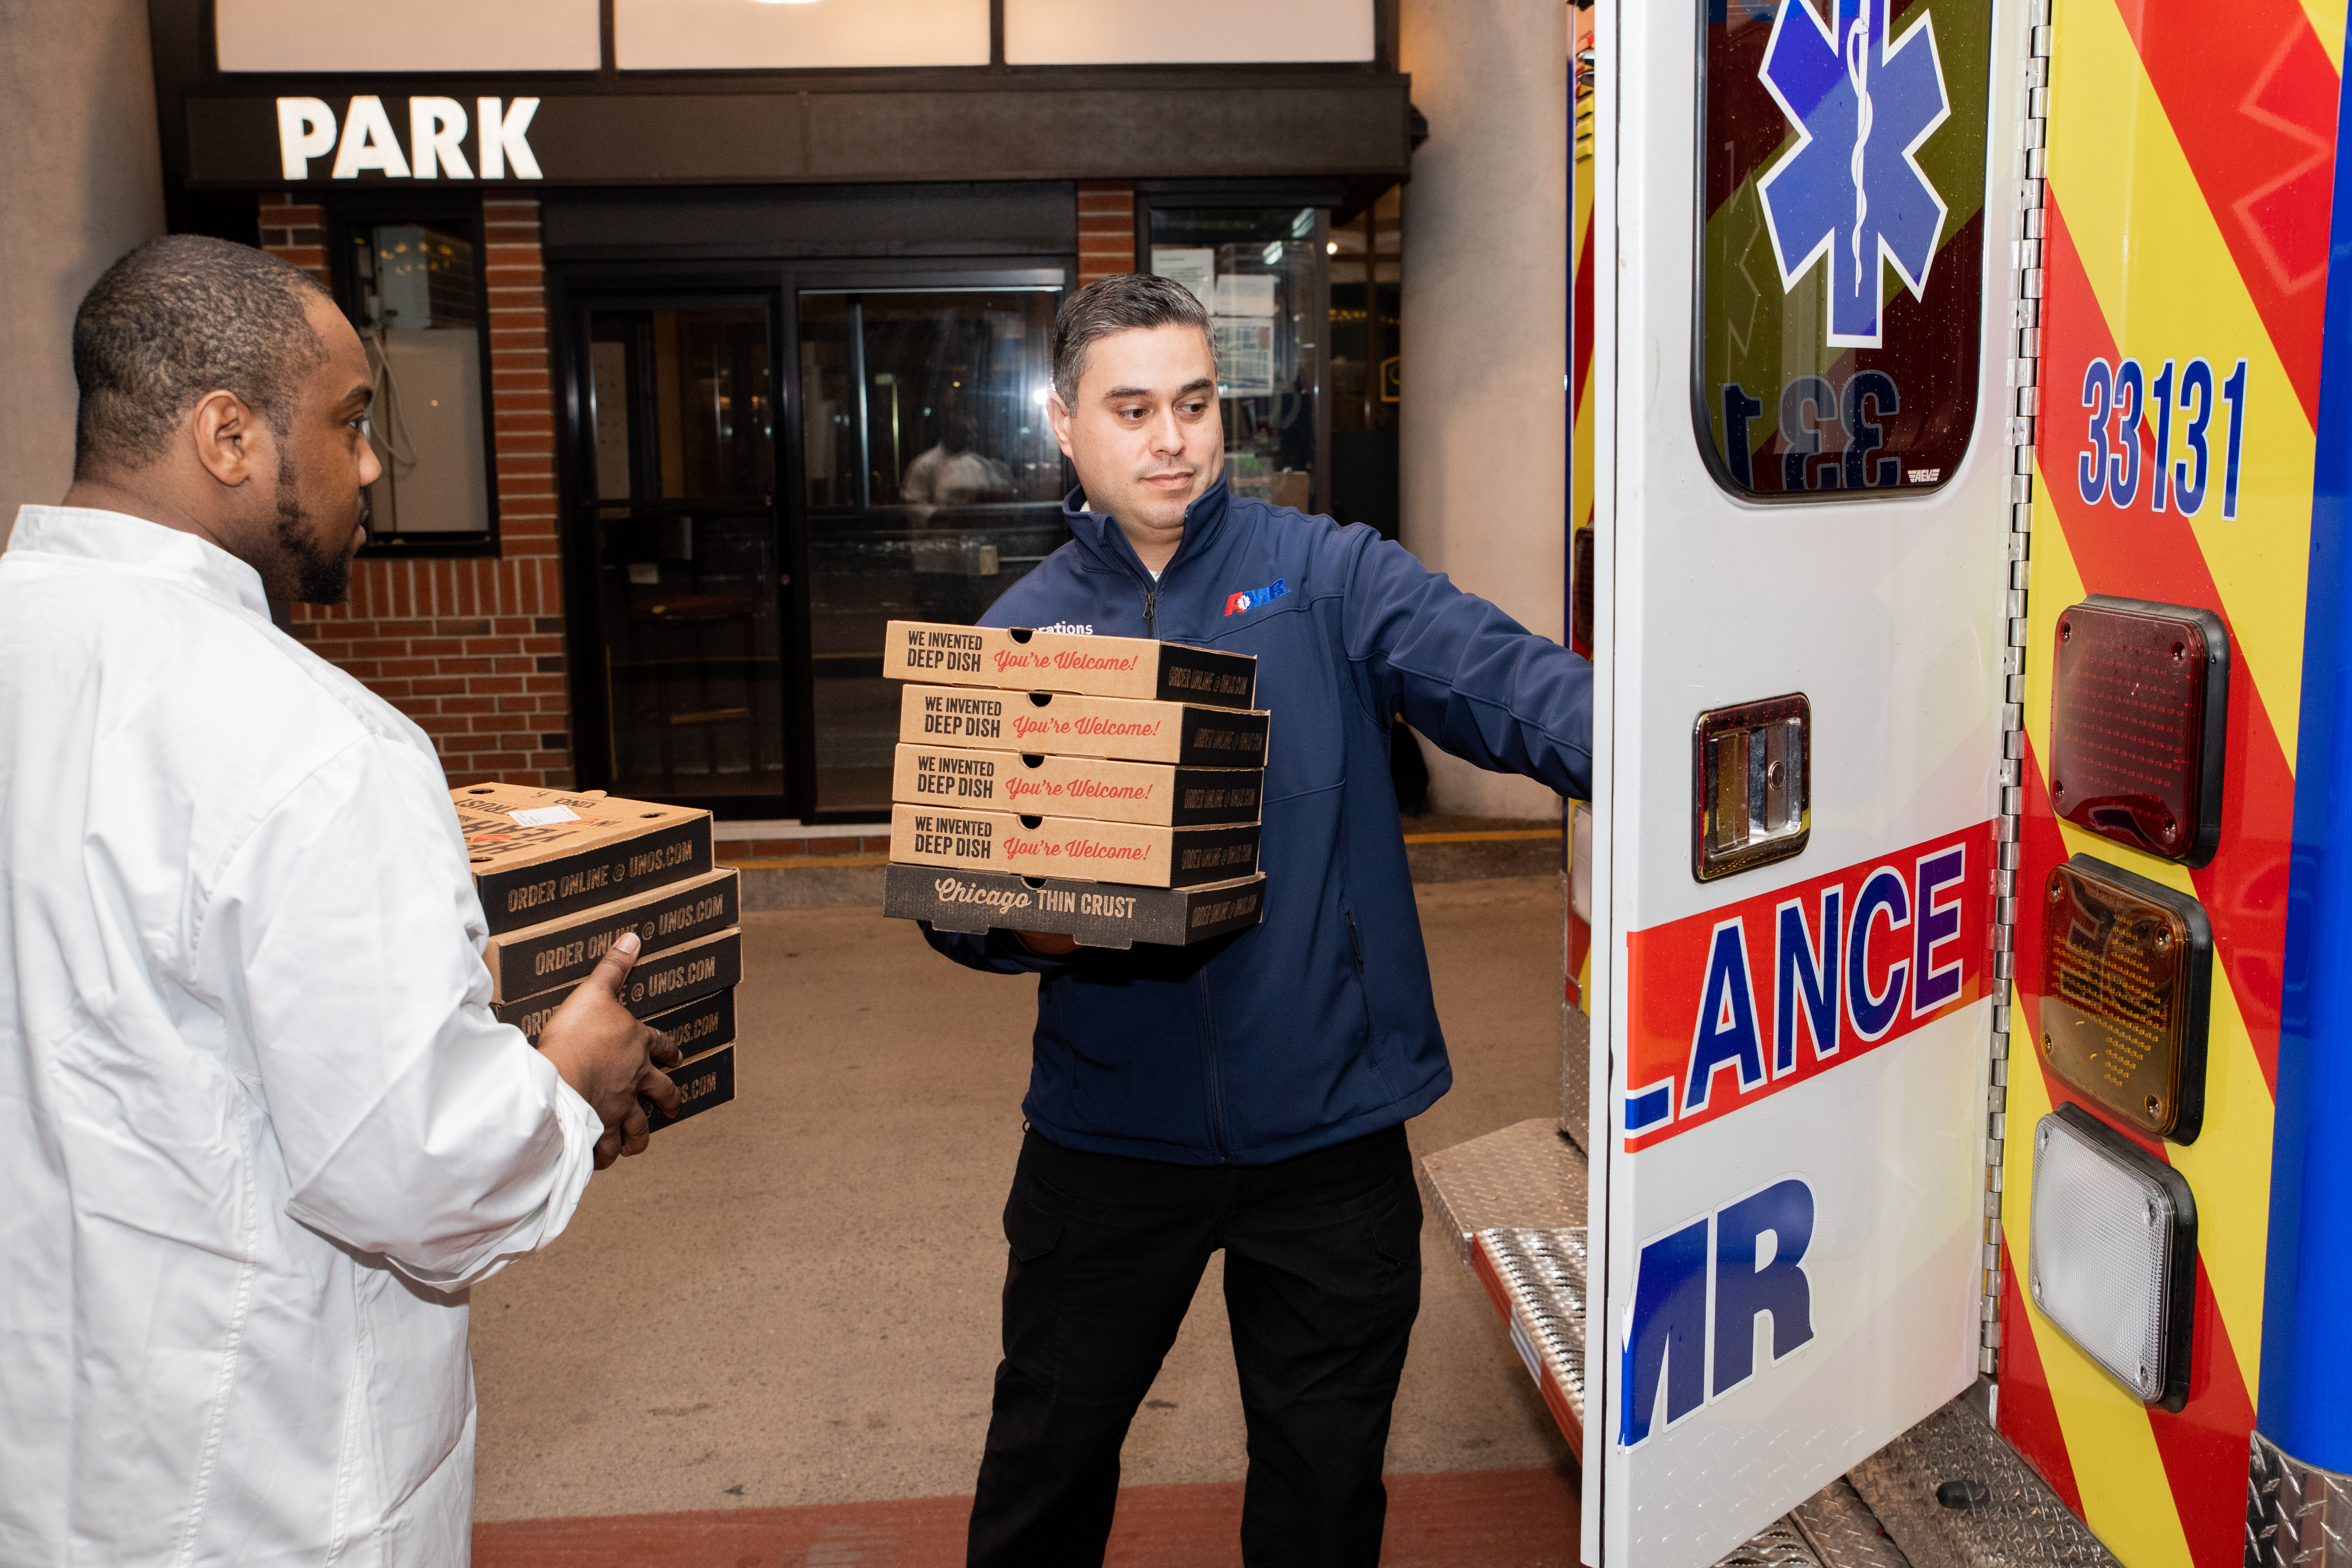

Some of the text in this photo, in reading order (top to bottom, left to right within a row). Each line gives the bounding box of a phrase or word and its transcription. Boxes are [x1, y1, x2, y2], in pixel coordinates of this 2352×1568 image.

[277, 96, 543, 180] PARK
[2079, 357, 2248, 521] 33131
[1913, 469, 1933, 483] AEV
[909, 631, 982, 650] WE INVENTED
[908, 648, 981, 672] DEEP DISH
[1054, 651, 1138, 671] Welcome!
[1168, 666, 1191, 688] ORDER
[1191, 670, 1214, 691] ONLINE
[1213, 677, 1220, 692] @
[925, 696, 1001, 716] WE INVENTED
[925, 714, 1000, 738] DEEP DISH
[1074, 717, 1161, 736] Welcome!
[918, 756, 994, 776] WE INVENTED
[918, 774, 993, 798] DEEP DISH
[1067, 779, 1153, 799] Welcome!
[454, 799, 519, 815] TRUST
[461, 820, 581, 842] YEAH
[915, 816, 992, 837] WE INVENTED
[915, 834, 990, 859] DEEP DISH
[1065, 840, 1151, 860] Welcome!
[508, 841, 692, 912] ORDER ONLINE @ UNOS.COM
[935, 878, 1136, 918] Chicago THIN CRUST
[1192, 905, 1211, 928] ORDER
[536, 941, 584, 975] ORDER
[642, 922, 654, 940] @
[659, 895, 723, 935] UNOS.COM
[631, 983, 644, 1002] @
[648, 956, 715, 997] UNOS.COM
[665, 1011, 719, 1046] NOS.COM
